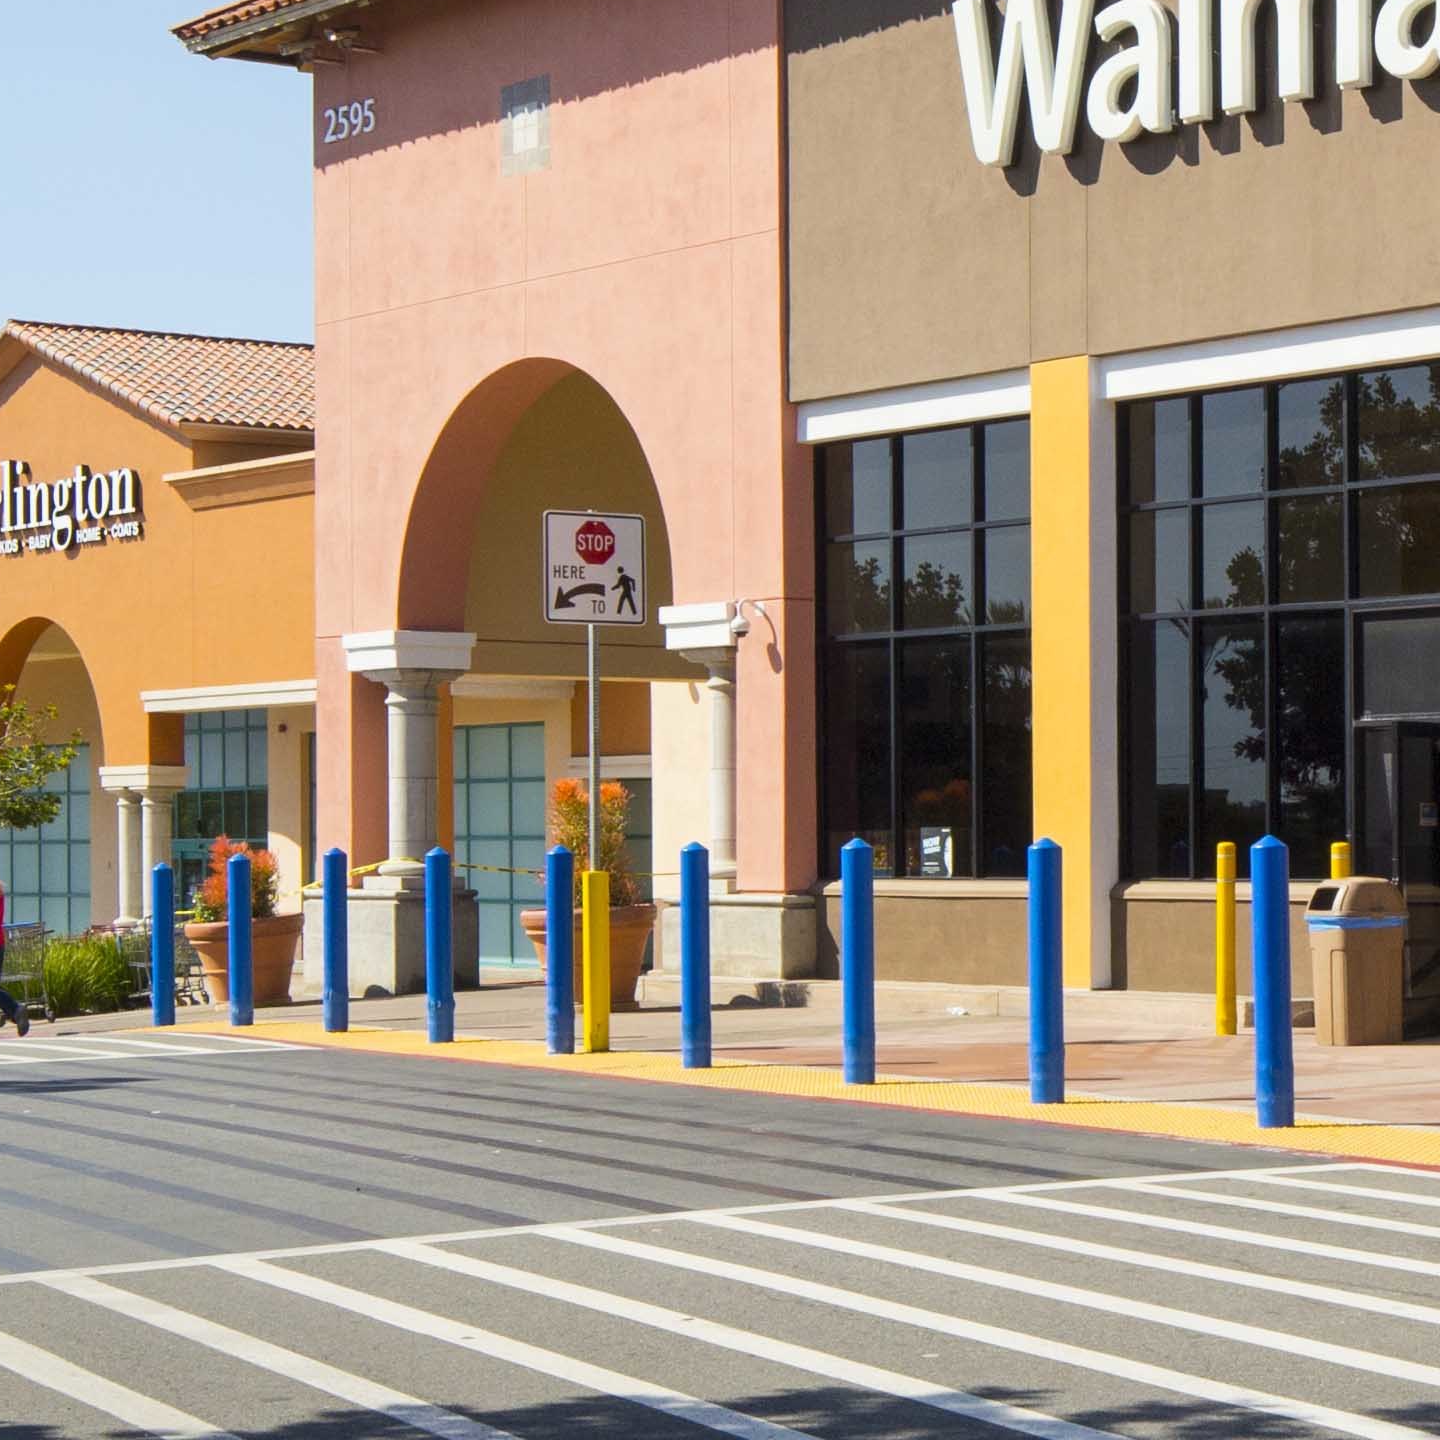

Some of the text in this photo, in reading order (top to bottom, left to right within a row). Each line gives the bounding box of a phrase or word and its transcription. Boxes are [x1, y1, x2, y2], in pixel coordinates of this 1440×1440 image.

[323, 98, 375, 143] 2595
[28, 534, 51, 550] BABY
[76, 527, 101, 544] HOME
[111, 521, 139, 539] COATS
[577, 533, 614, 552] STOP
[552, 564, 586, 580] HERE
[591, 599, 606, 614] TO
